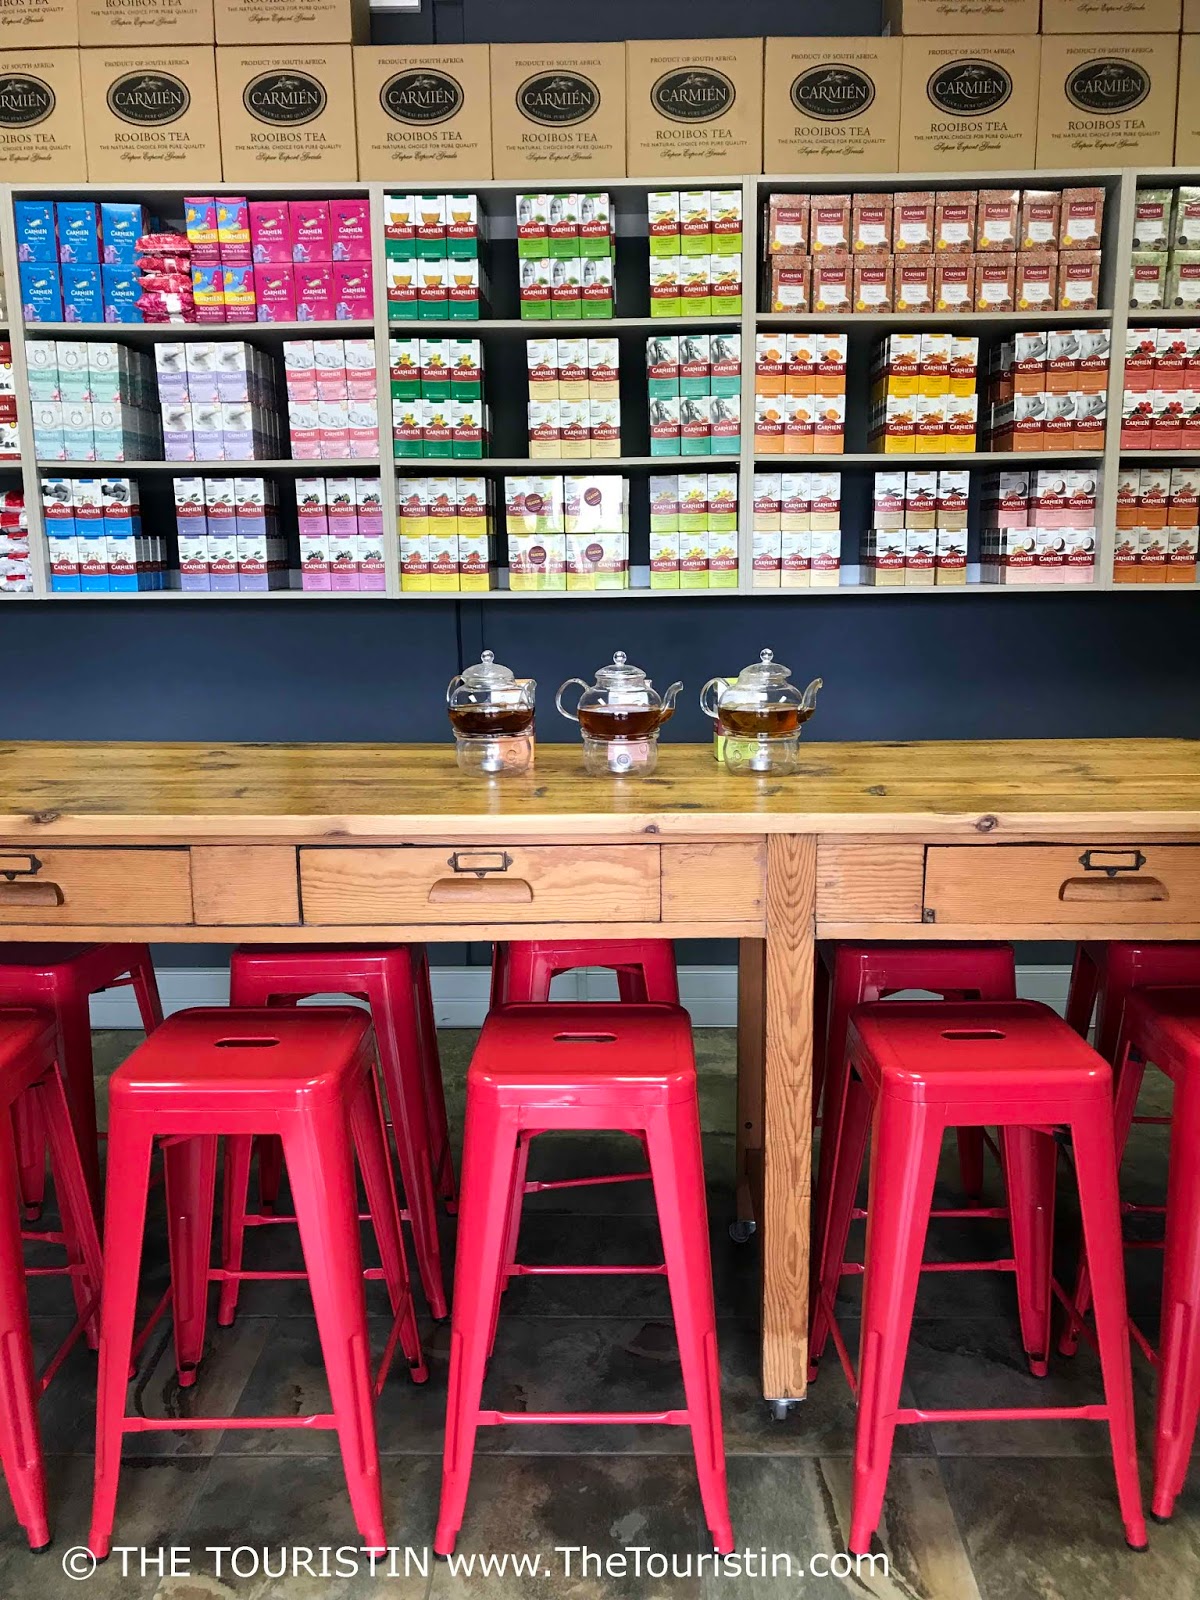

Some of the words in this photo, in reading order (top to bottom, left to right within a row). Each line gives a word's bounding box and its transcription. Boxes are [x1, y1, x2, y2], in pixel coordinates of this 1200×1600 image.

[0, 91, 47, 111] RMIÉN
[930, 122, 982, 132] ROOIBOS
[986, 122, 1008, 131] TEA
[1068, 120, 1120, 130] ROOIBOS
[1124, 120, 1146, 129] TEA
[656, 129, 707, 139] ROOIBOS
[711, 129, 733, 138] TEA
[794, 127, 846, 136] ROOIBOS
[849, 127, 871, 136] TEA
[34, 134, 56, 143] TEA
[114, 132, 165, 142] ROOIBOS
[169, 132, 190, 141] TEA
[250, 133, 301, 142] ROOIBOS
[305, 133, 326, 142] TEA
[386, 132, 437, 142] ROOIBOS
[441, 132, 463, 141] TEA
[522, 133, 573, 143] ROOIBOS
[576, 133, 598, 142] TEA
